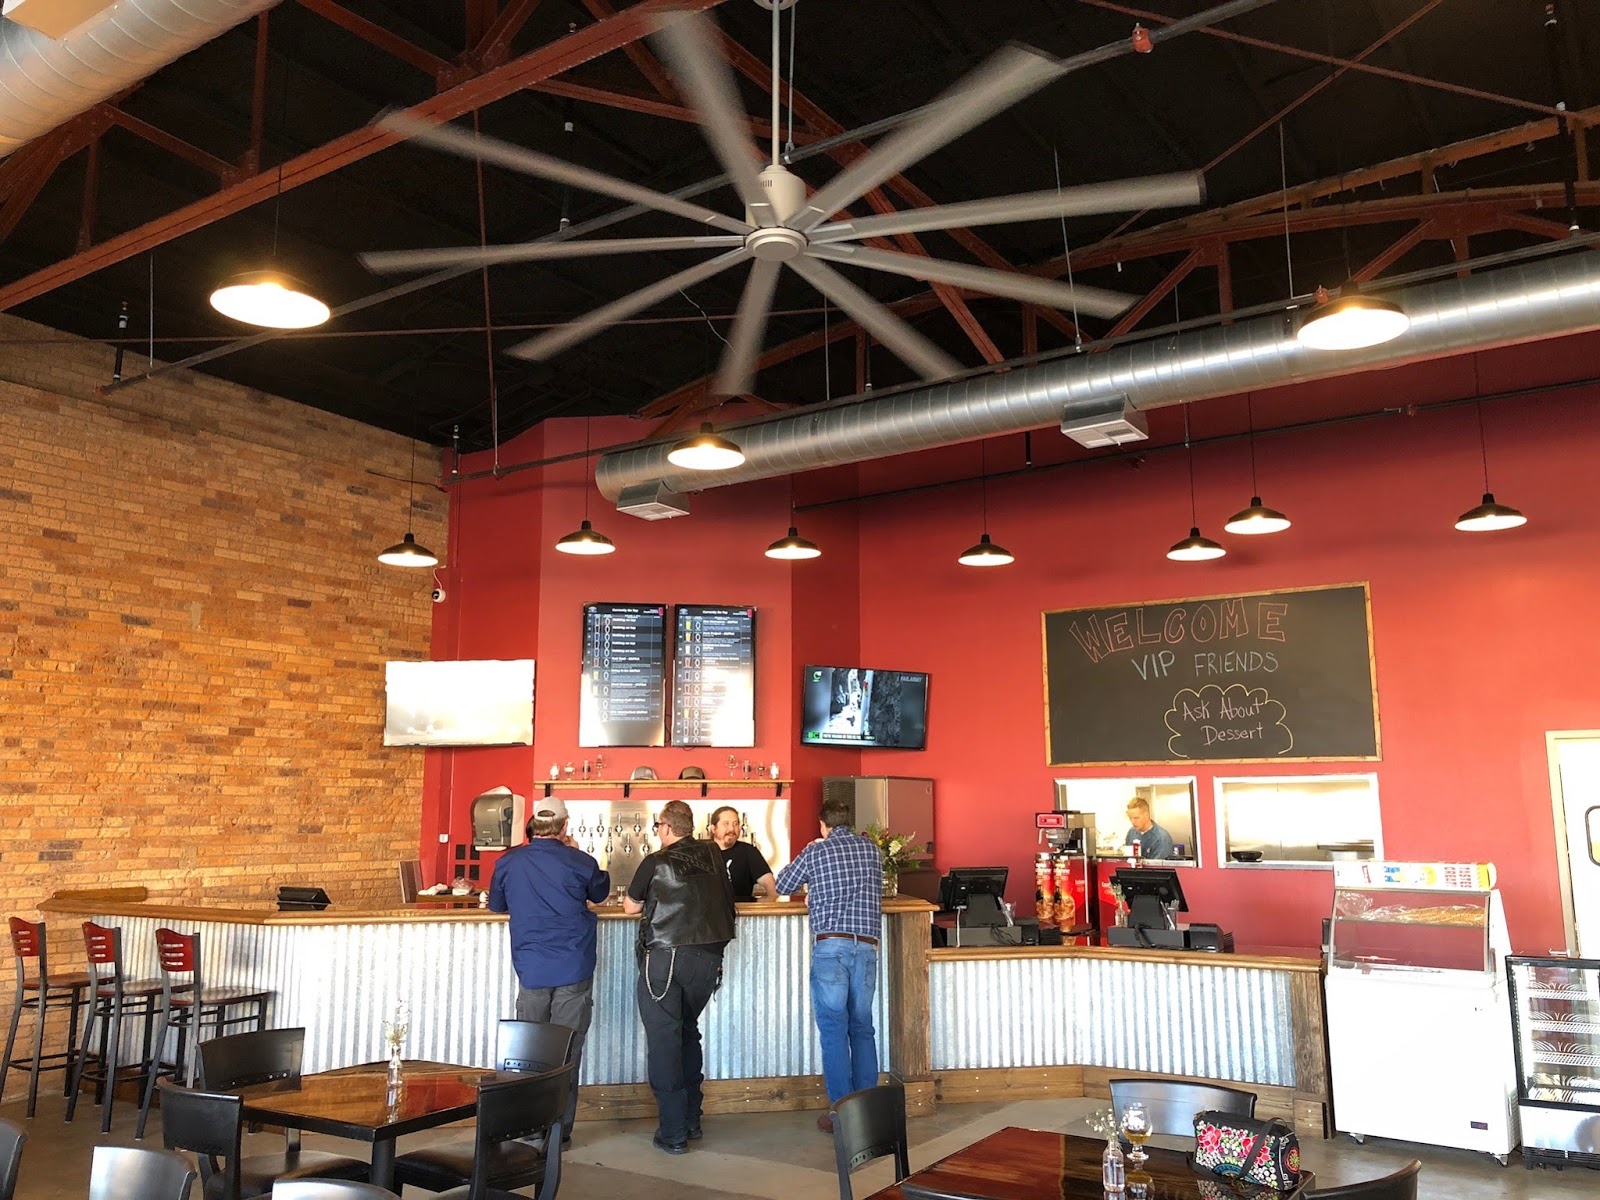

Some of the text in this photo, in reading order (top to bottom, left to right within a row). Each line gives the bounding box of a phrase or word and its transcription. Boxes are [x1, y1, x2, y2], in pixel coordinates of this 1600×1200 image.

[1069, 598, 1288, 663] WELCOME
[1131, 650, 1279, 680] VIP FRIENDS
[1182, 697, 1264, 721] Ask About
[1200, 725, 1263, 745] Dessert
